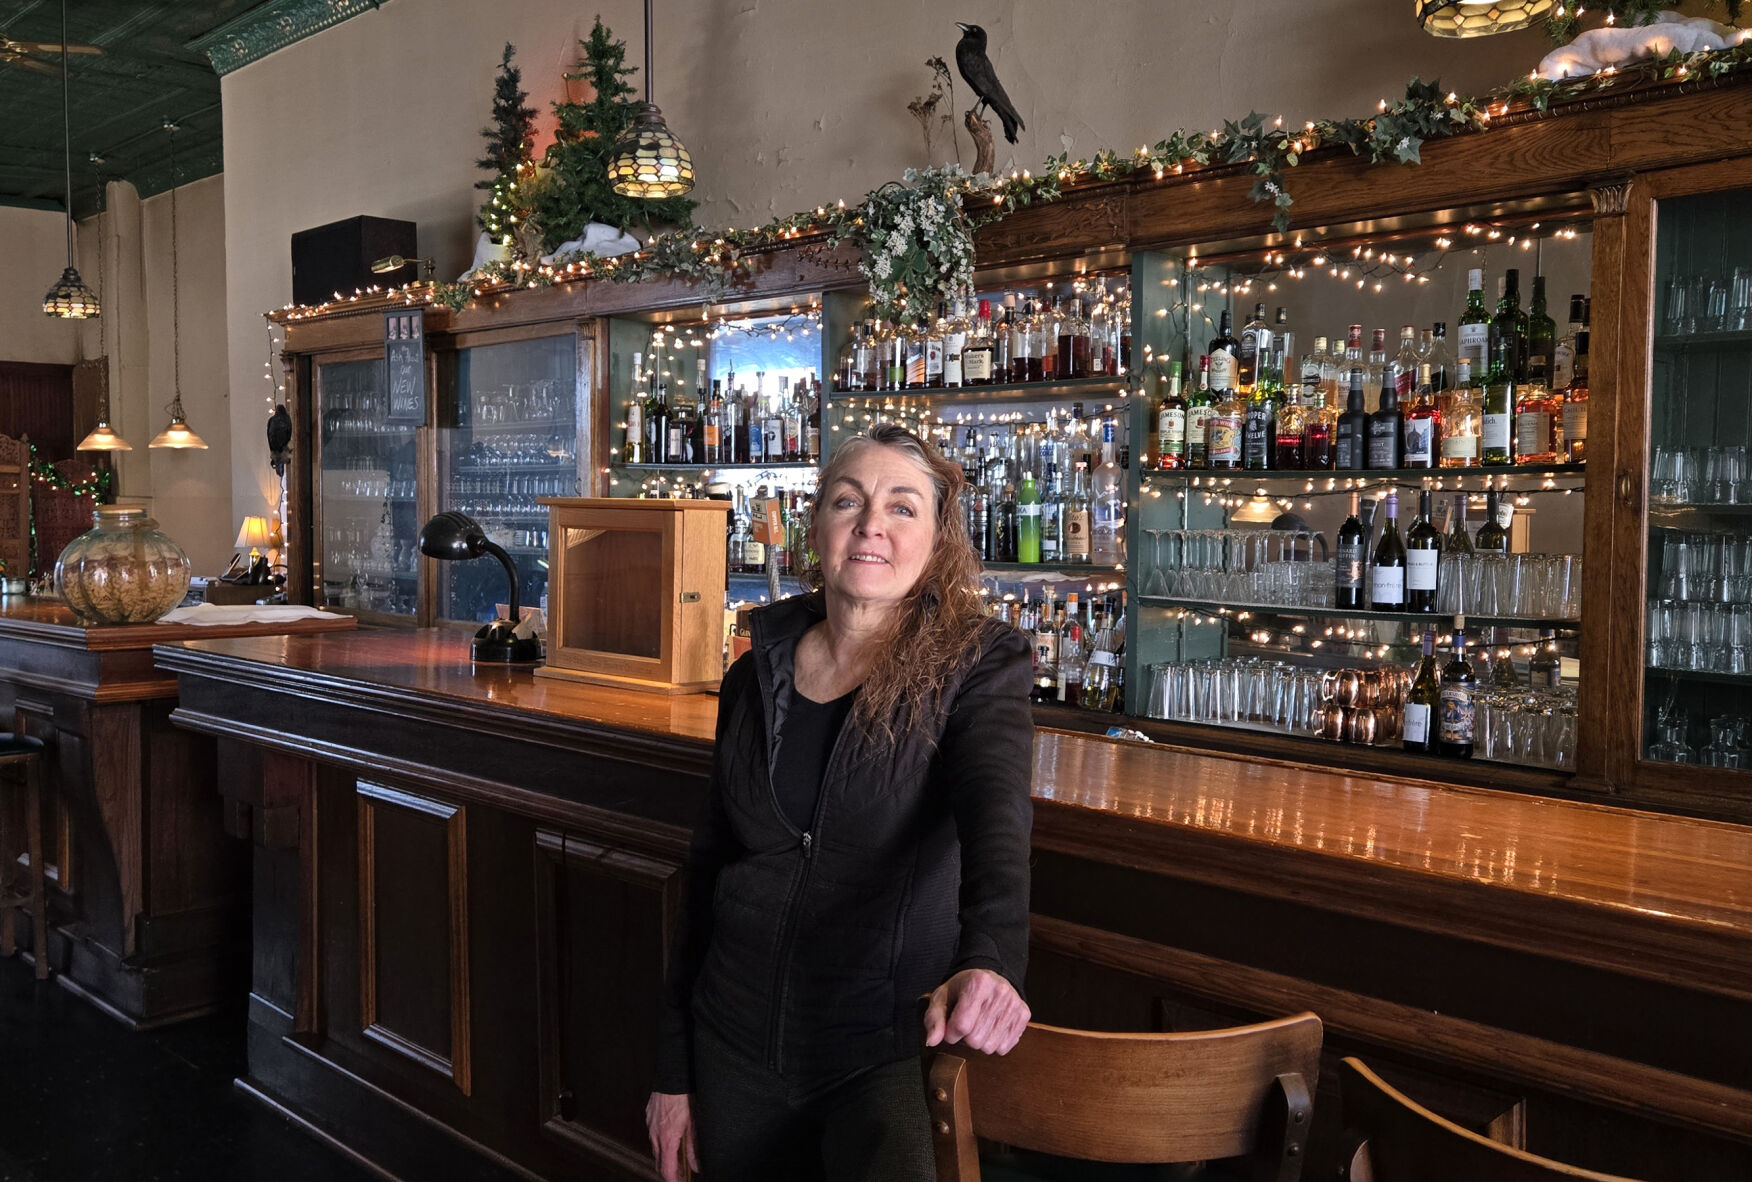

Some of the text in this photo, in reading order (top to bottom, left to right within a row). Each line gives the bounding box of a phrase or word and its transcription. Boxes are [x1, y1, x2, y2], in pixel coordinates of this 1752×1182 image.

[392, 375, 417, 395] NEW
[393, 395, 420, 411] WINES
[1160, 409, 1186, 421] JAMESON
[1188, 405, 1214, 419] JAMESO
